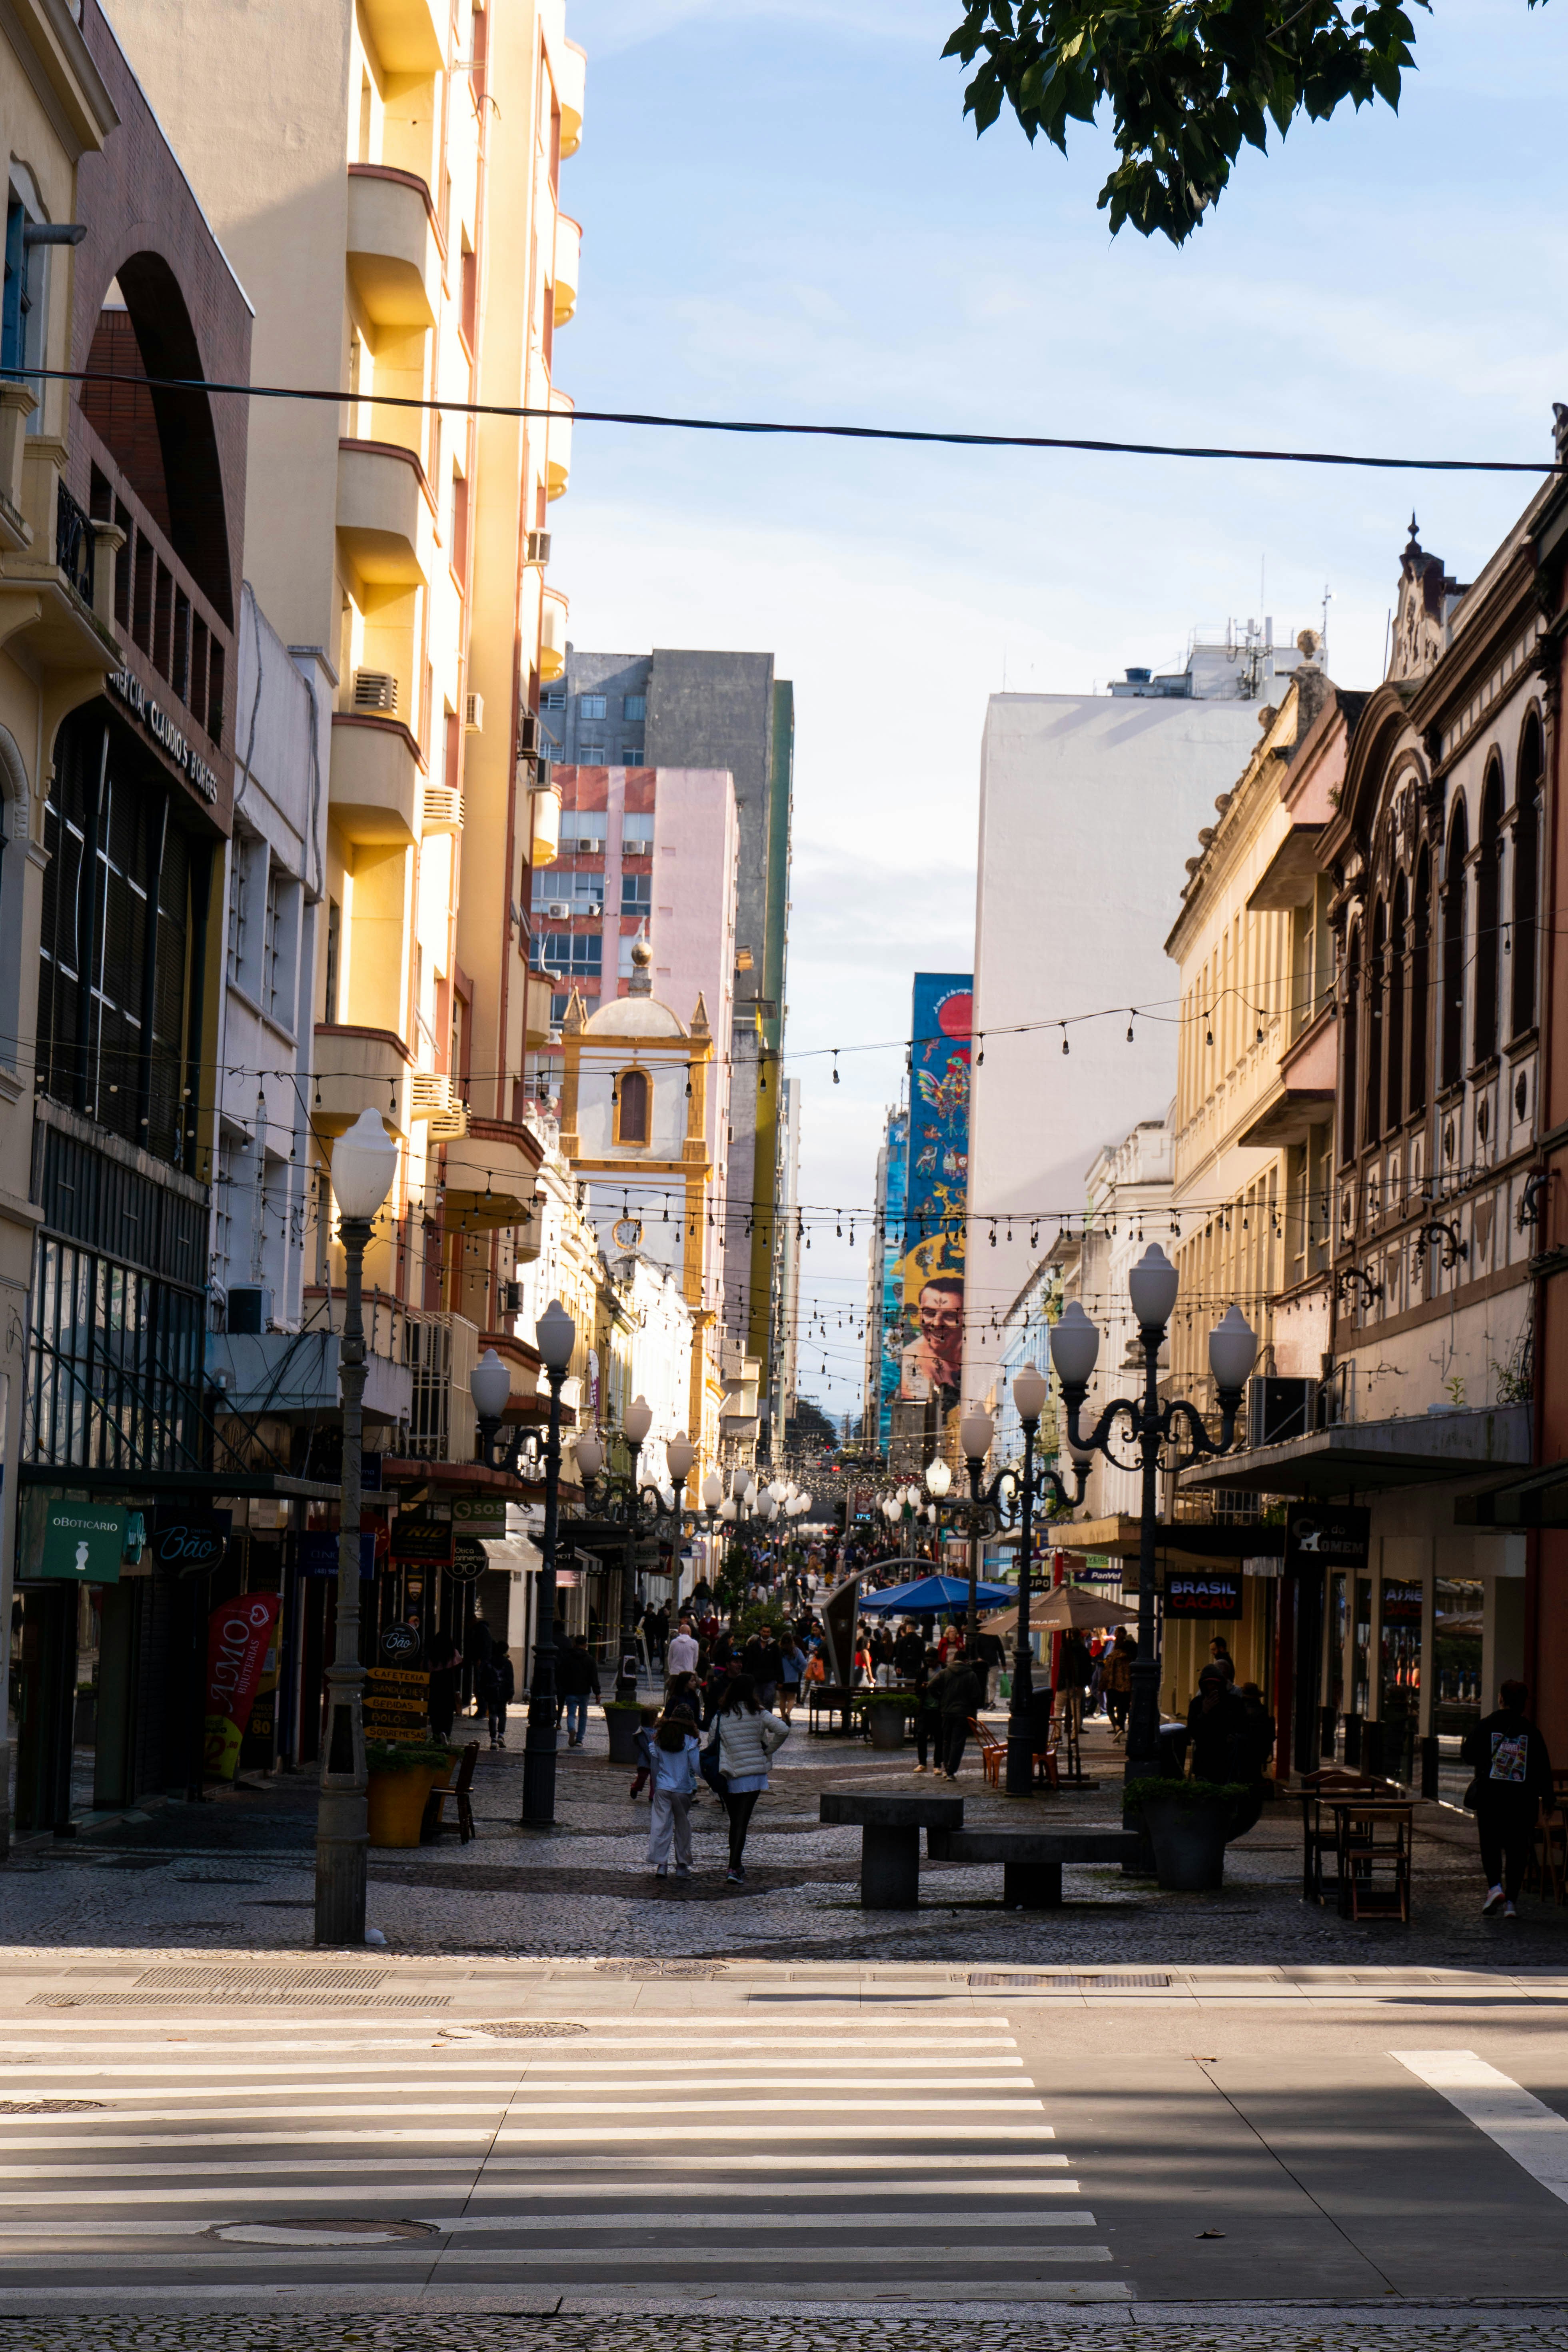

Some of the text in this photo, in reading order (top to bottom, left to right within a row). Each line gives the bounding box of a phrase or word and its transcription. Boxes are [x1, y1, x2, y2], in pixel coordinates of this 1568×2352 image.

[191, 751, 217, 805] BORGES
[1331, 1524, 1346, 1535] do
[154, 1525, 217, 1560] Bão
[1171, 1581, 1237, 1595] BRASIL
[1171, 1595, 1235, 1610] CACAU
[382, 1633, 412, 1649] Bão
[211, 1619, 250, 1713] AMO
[237, 1639, 260, 1695] BIJUTERIAS
[374, 1669, 424, 1682] CAFETERIA
[373, 1699, 414, 1710] BEBIDAS
[372, 1712, 407, 1724] BOLOS
[252, 1719, 271, 1735] 80
[369, 1727, 426, 1739] SOBREMESAS
